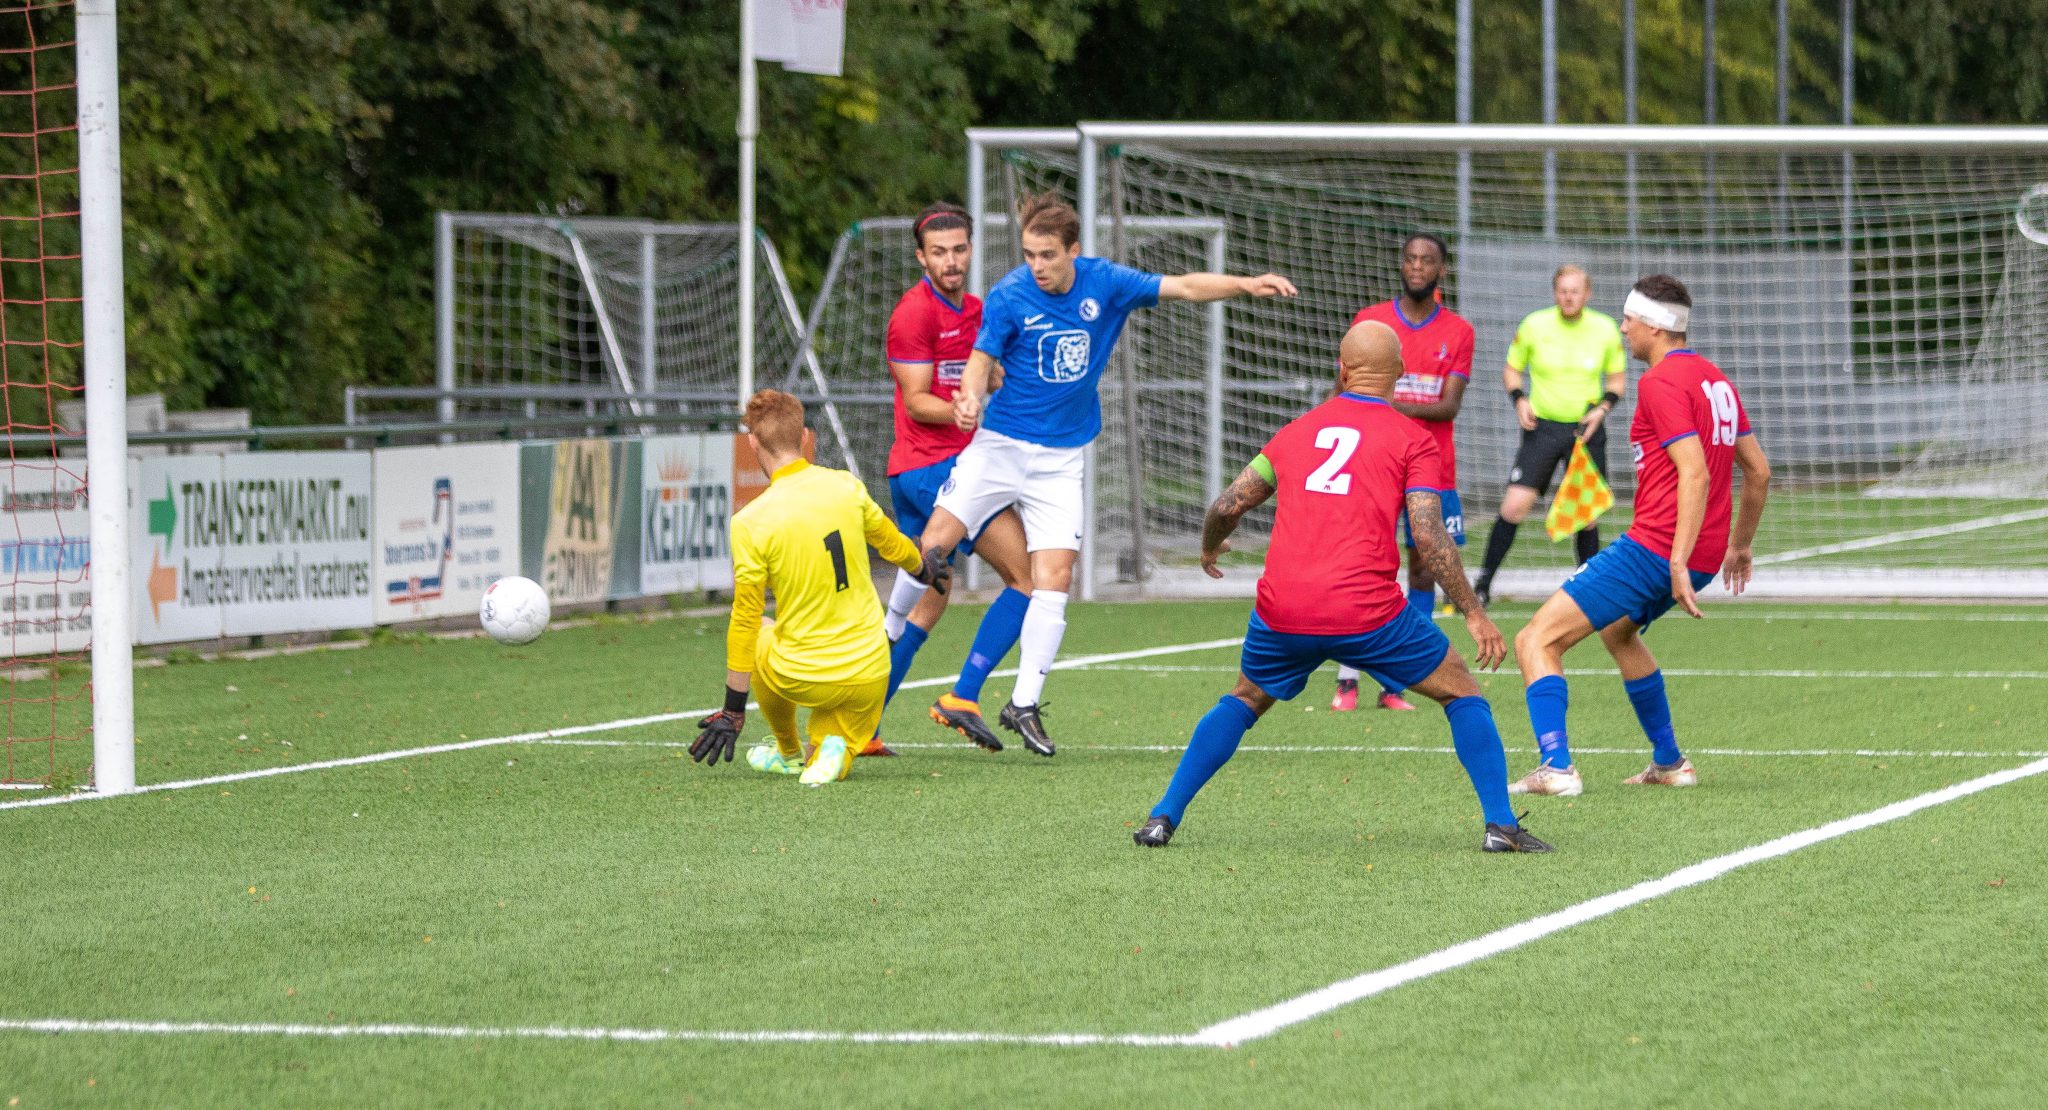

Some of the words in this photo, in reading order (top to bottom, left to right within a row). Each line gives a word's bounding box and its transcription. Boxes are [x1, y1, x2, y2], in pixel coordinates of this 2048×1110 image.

[1701, 380, 1738, 446] 19
[1305, 426, 1360, 495] 2
[181, 479, 368, 548] TRANSFERMARKT.nu
[1446, 515, 1462, 533] 21
[181, 551, 301, 607] Amateurvoetbal
[302, 557, 369, 599] vacatures
[823, 530, 849, 593] 1
